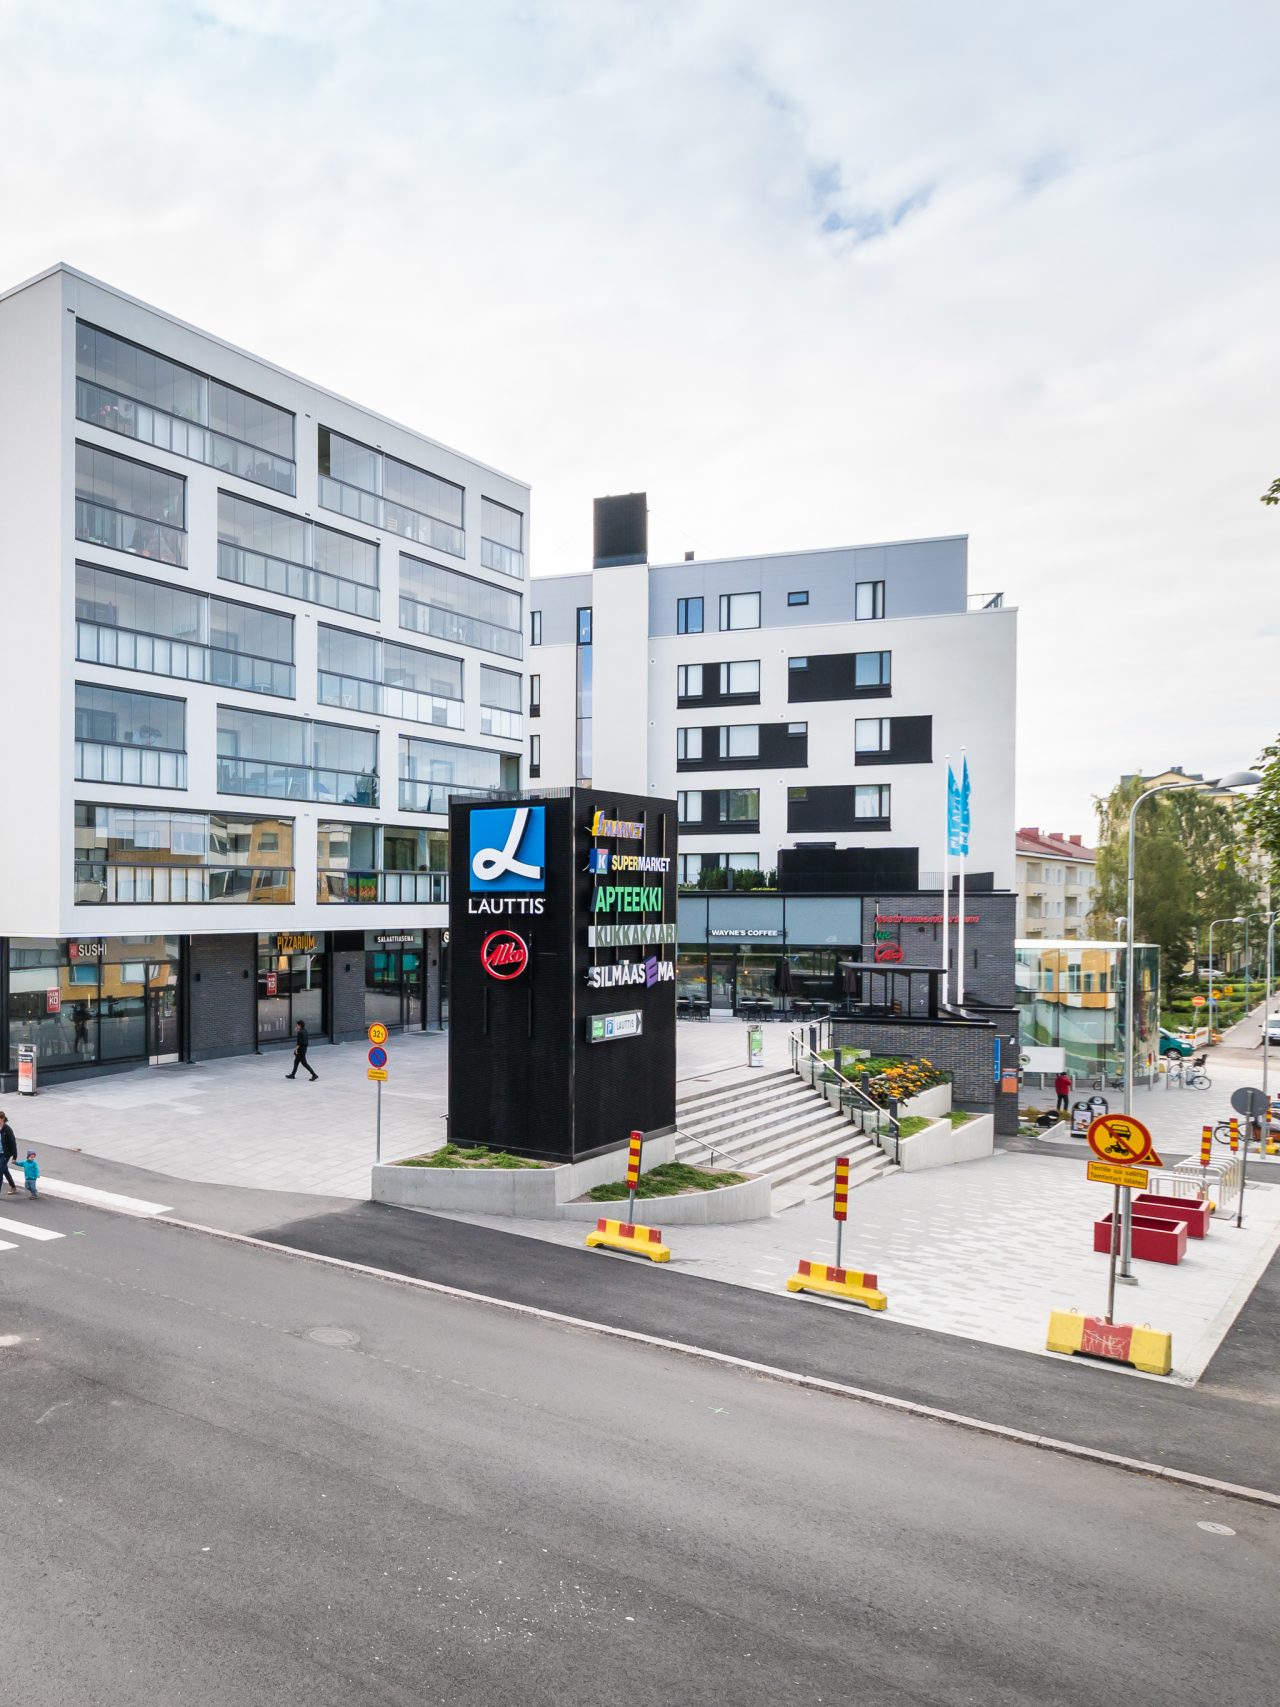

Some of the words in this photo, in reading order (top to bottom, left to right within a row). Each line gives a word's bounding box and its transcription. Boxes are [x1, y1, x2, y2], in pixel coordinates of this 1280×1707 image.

[611, 855, 670, 872] SUPERMARKET
[468, 899, 545, 914] LAUTTIS
[595, 886, 662, 913] APTEEKKI
[277, 935, 315, 950] PIZZARIUM
[78, 944, 107, 957] SUSHI
